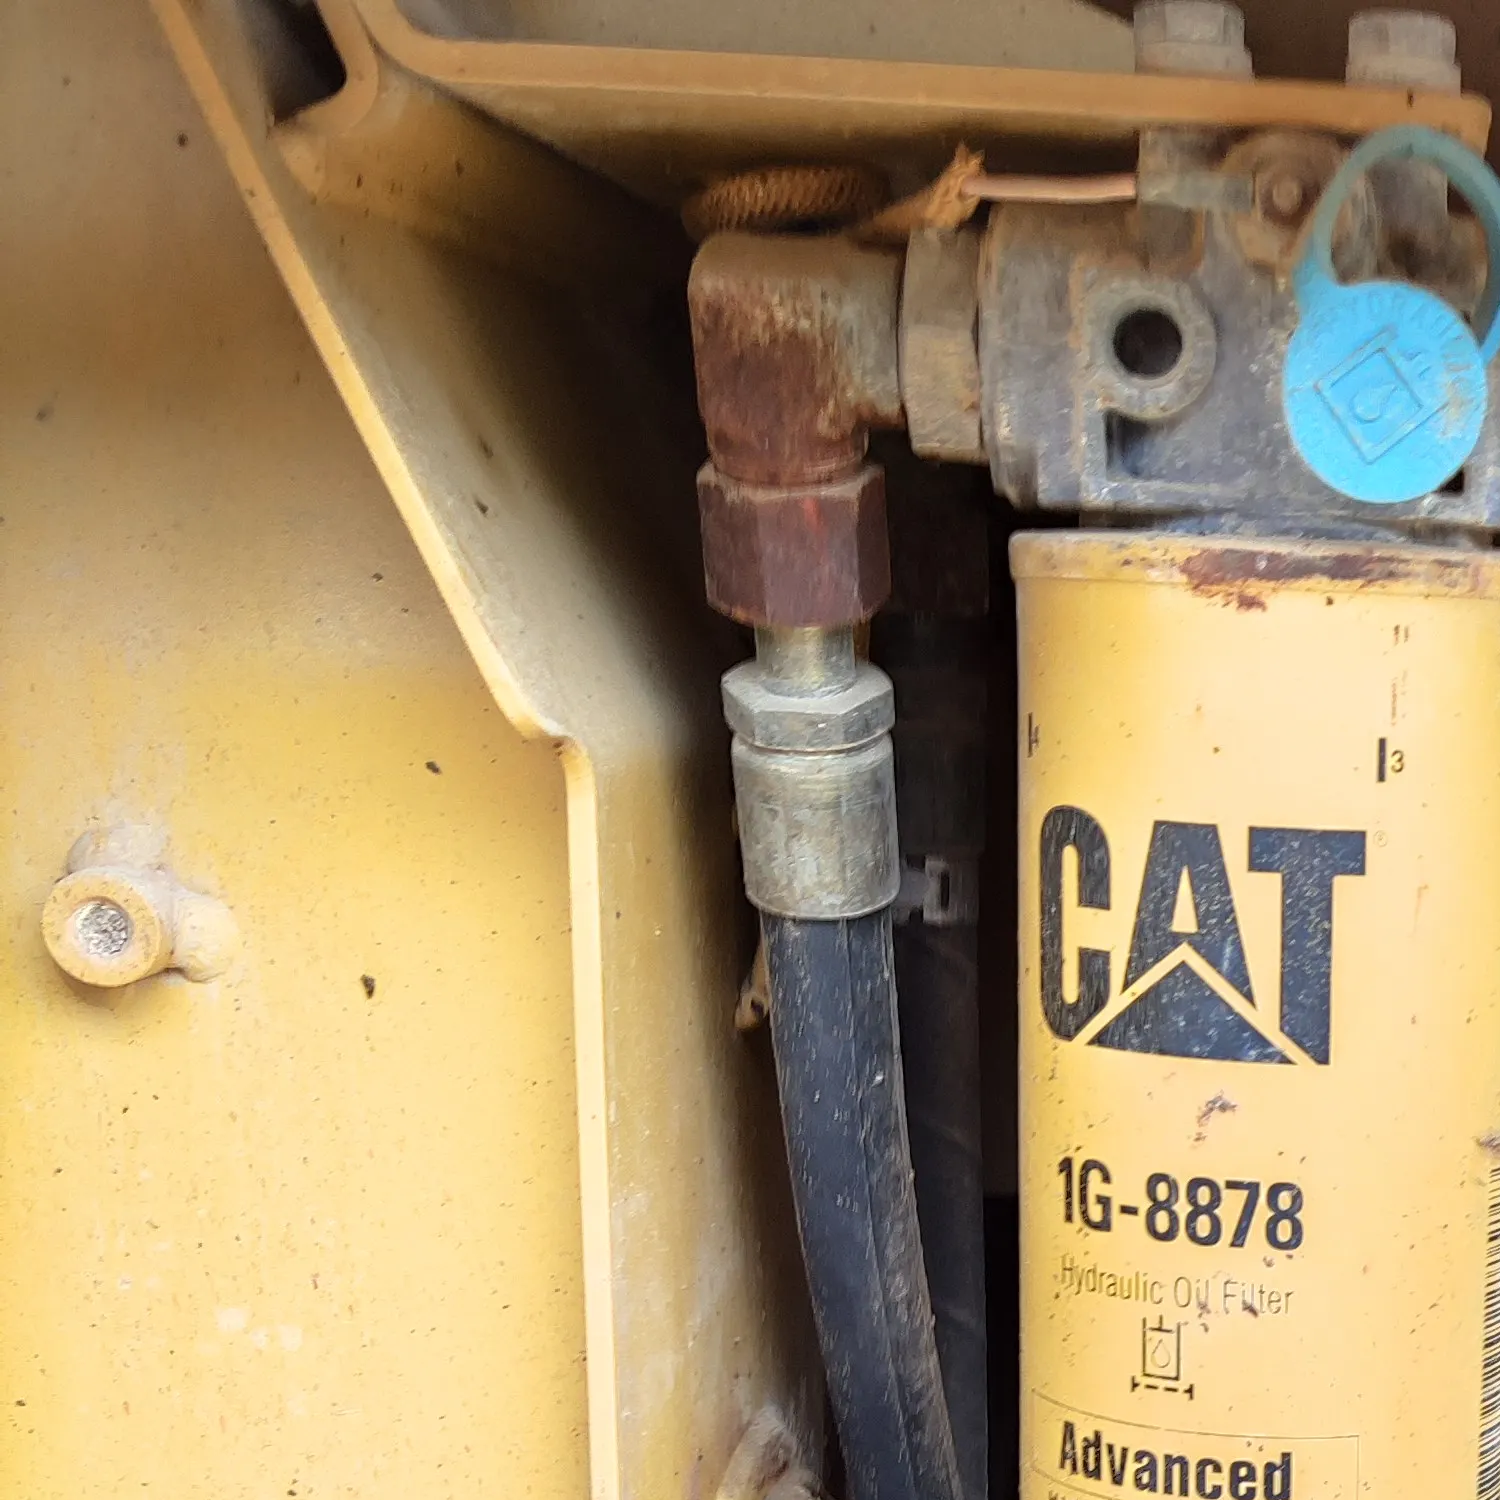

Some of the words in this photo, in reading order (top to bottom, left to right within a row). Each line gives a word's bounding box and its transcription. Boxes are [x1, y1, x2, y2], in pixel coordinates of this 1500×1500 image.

[1390, 750, 1405, 773] 3
[1040, 804, 1367, 1066] CAT
[1057, 1155, 1304, 1251] 1G-8878
[1059, 1252, 1165, 1305] Hydraulic
[1173, 1275, 1210, 1312] Oil
[1222, 1278, 1294, 1316] Filter
